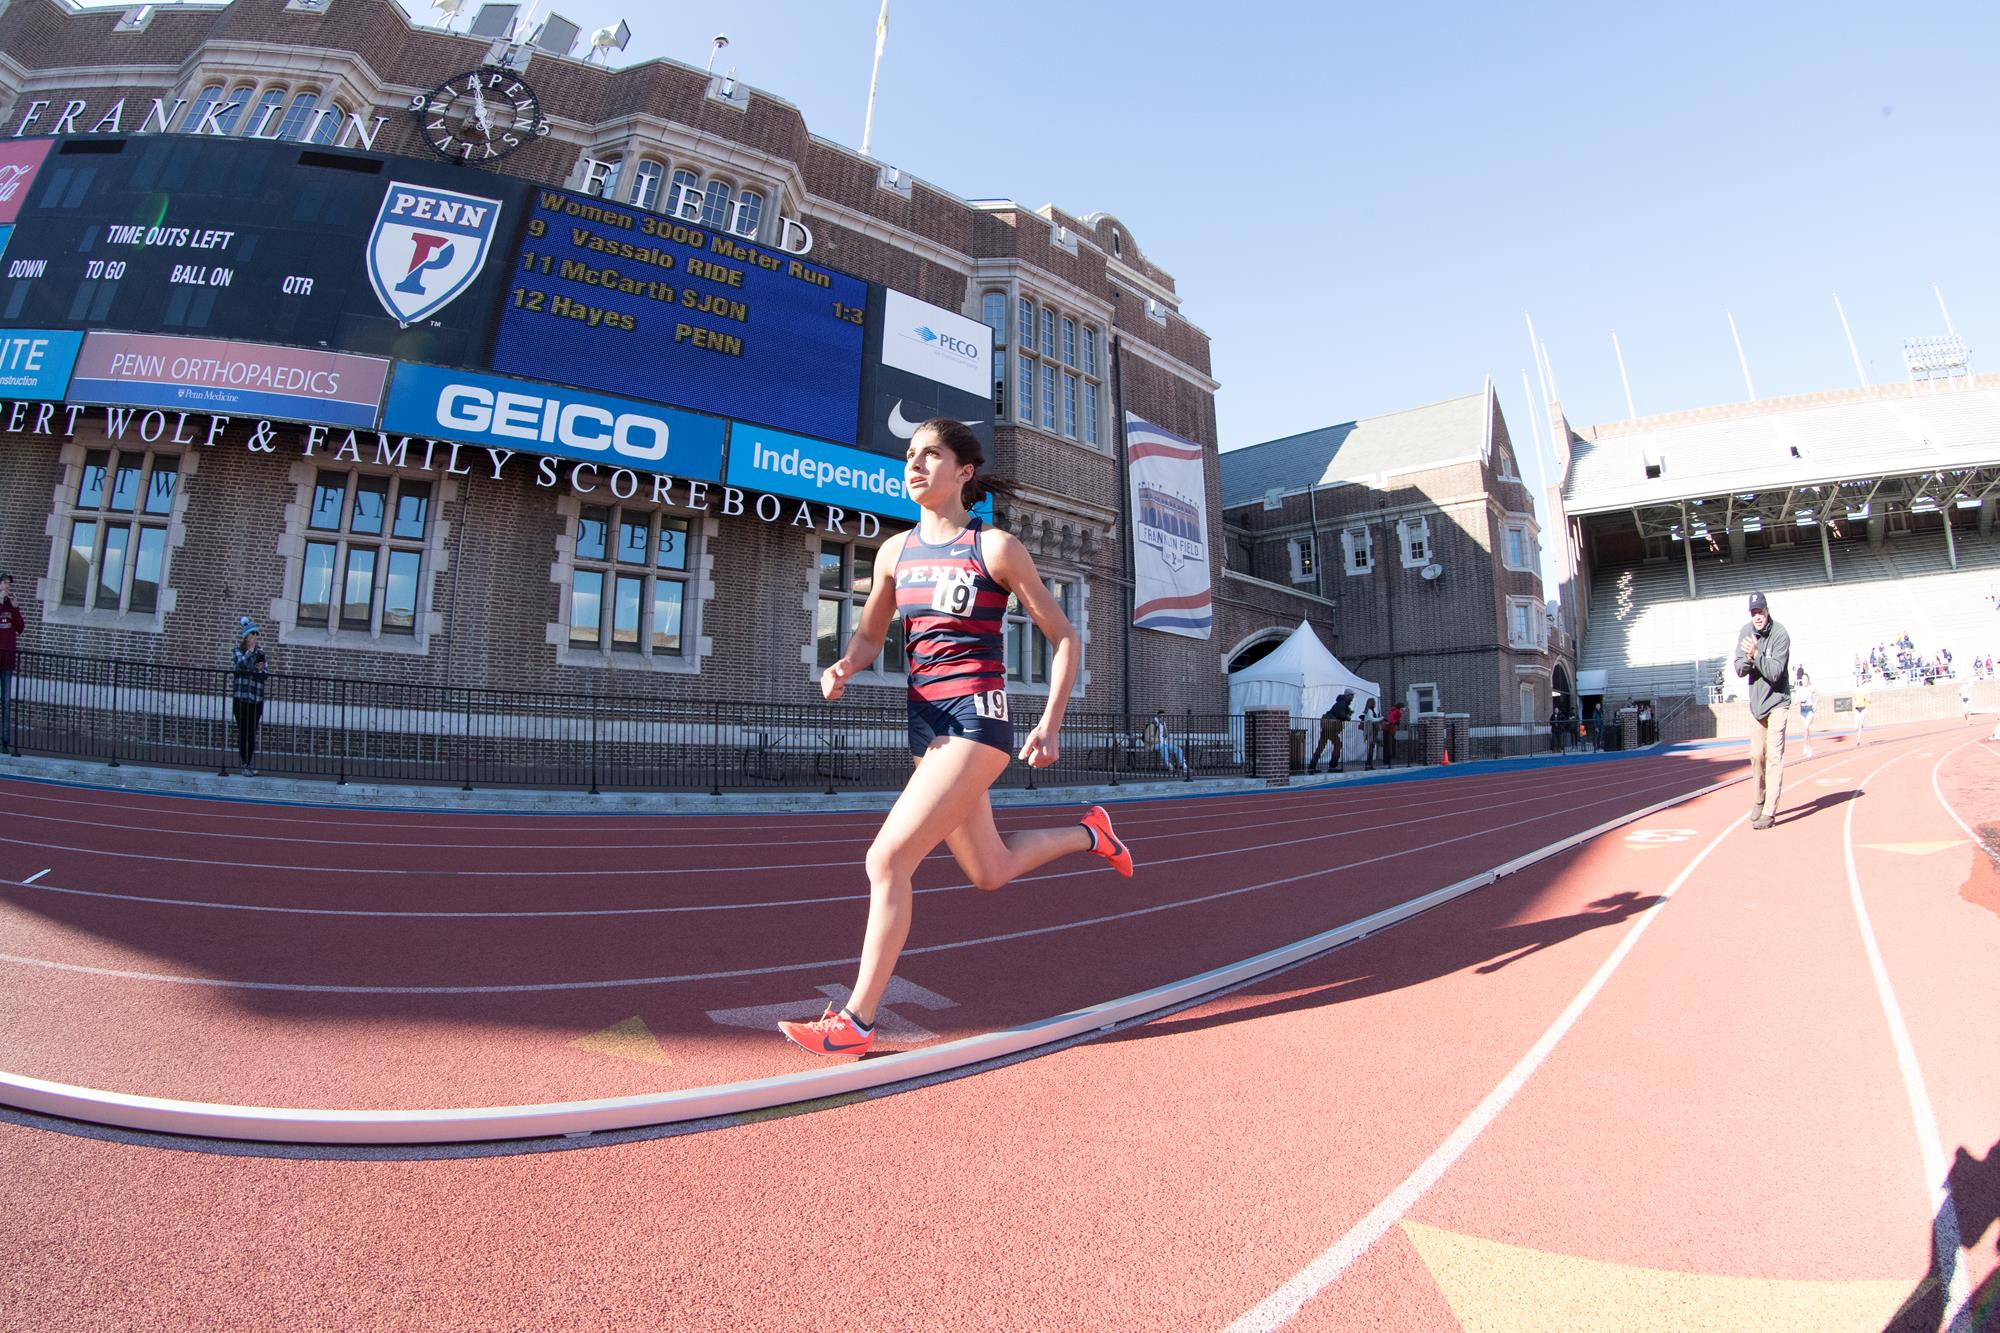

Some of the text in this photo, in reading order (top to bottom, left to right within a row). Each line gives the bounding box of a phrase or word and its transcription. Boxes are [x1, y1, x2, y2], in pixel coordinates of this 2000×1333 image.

[12, 98, 813, 255] FRANKLIN FIELD
[391, 193, 488, 228] PENN
[106, 225, 234, 250] TIME OUTS LEFT
[541, 192, 831, 288] Women 3000 Meter Run
[8, 259, 48, 278] DOWN
[528, 219, 743, 288] 9 Vassalo RIDE
[85, 260, 126, 280] TO GO
[170, 264, 234, 287] BALL ON
[282, 275, 314, 295] QTR
[524, 251, 748, 322] 11 McCarth SJON
[513, 288, 742, 357] 12 Hayes PENN
[0, 338, 49, 370] ITE
[940, 333, 978, 359] PECO
[110, 353, 340, 395] PENN ORTHOPAEDICS
[185, 389, 239, 402] Penn Medicine
[436, 384, 670, 461] GEICO
[0, 401, 881, 539] ERT WOLF & FAMILY SCOREBOARD
[1143, 527, 1199, 557] FRANKLIN FIELD
[896, 565, 979, 589] PENN
[975, 690, 1005, 719] 19
